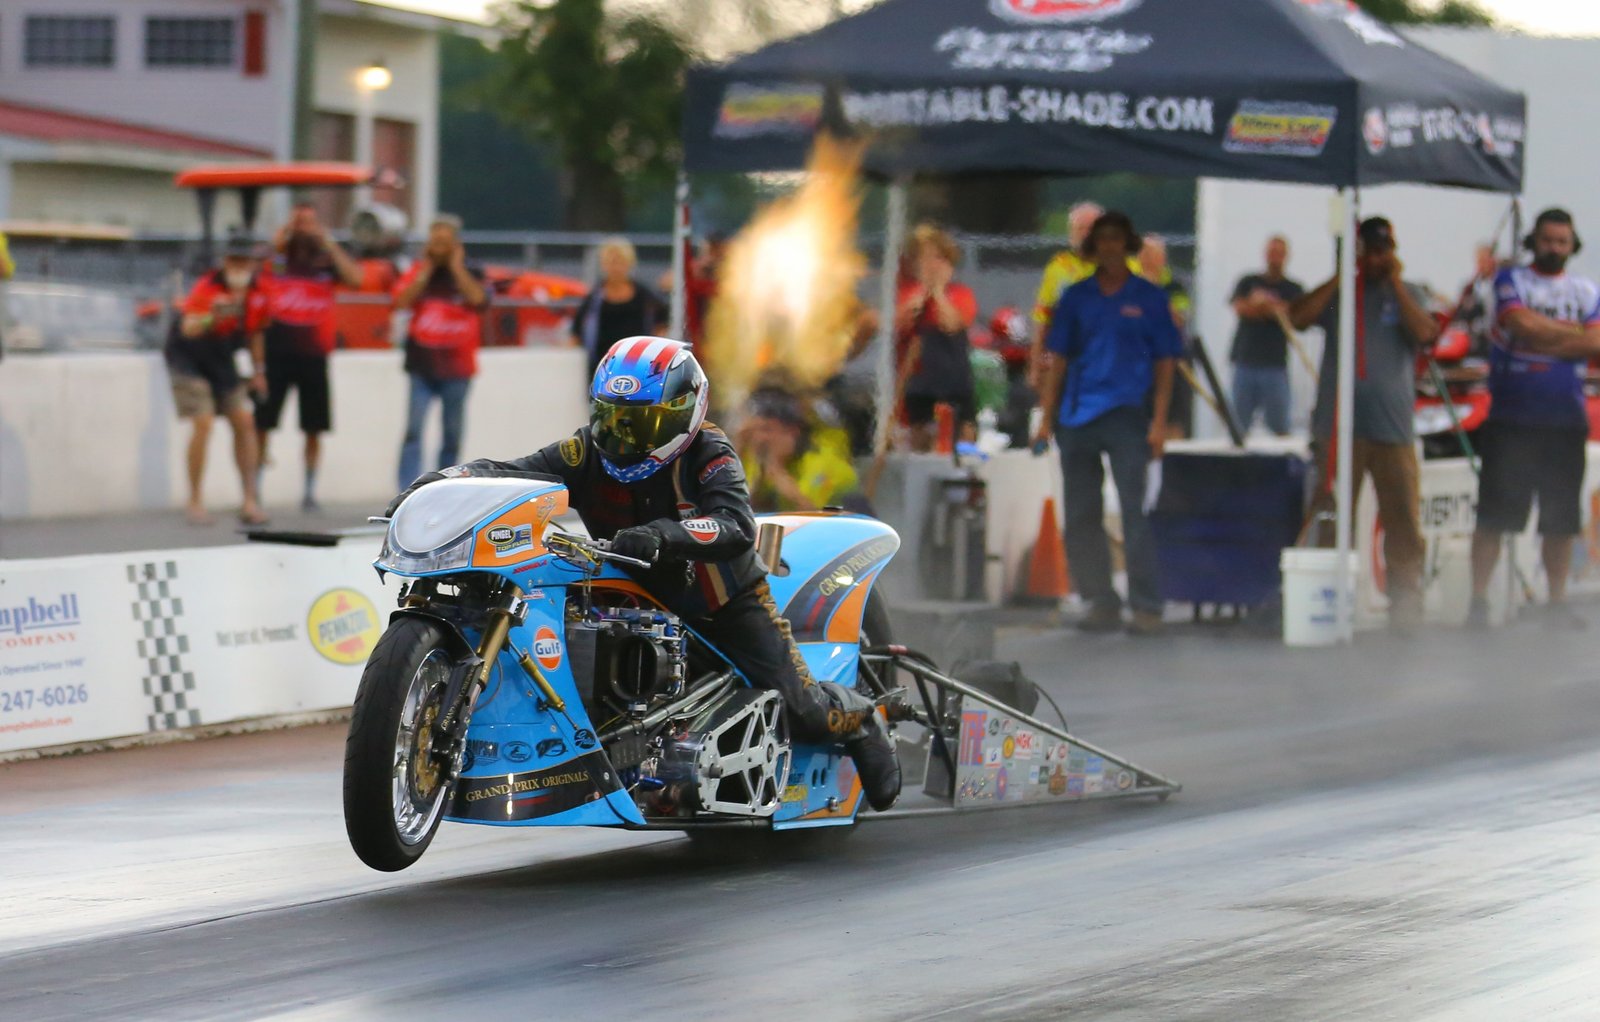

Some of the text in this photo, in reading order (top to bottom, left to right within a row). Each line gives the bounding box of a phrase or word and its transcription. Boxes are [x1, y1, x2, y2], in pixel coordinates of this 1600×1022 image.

[843, 85, 1214, 133] RTABLE-SHADE.COM
[683, 520, 718, 530] Gulf
[491, 529, 512, 540] PINGEL
[0, 632, 76, 648] OMPANY
[535, 642, 560, 655] Gulf
[1, 683, 88, 712] 247-6026
[466, 784, 511, 802] GRAND
[514, 778, 540, 793] PRIX
[542, 770, 589, 788] ORIGINALS
